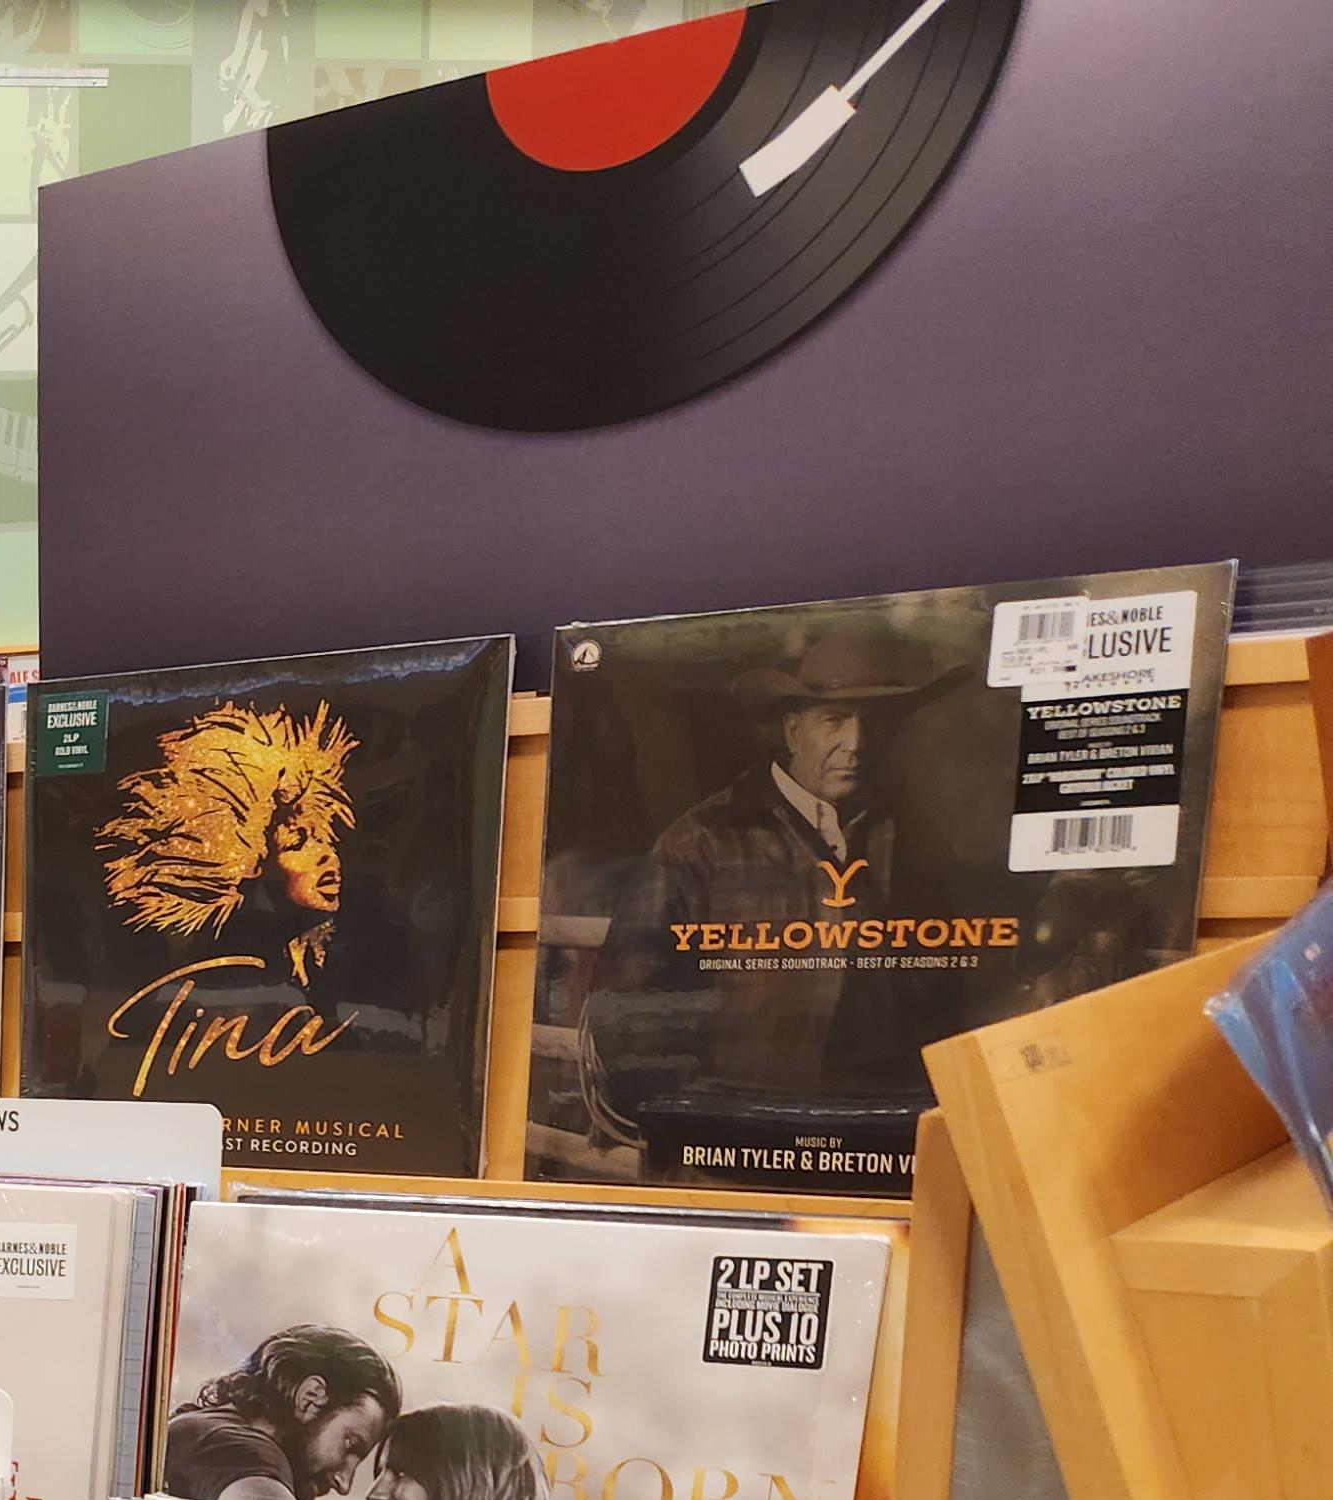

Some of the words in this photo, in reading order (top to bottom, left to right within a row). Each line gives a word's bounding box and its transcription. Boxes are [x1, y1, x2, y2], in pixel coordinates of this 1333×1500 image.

[46, 711, 98, 729] EXCLUSIVE
[1026, 695, 1183, 721] YELLOWSTONE
[63, 732, 80, 744] 2LP
[670, 916, 1021, 952] YELLOWSTONE
[699, 958, 743, 971] ORIGINAL
[744, 957, 780, 971] SERIES
[781, 957, 848, 970] SOUNDTRACK
[856, 957, 882, 969] BEST
[884, 957, 897, 969] OF
[900, 956, 948, 969] SEASONS
[950, 956, 958, 968] 2
[969, 956, 978, 968] 3
[106, 954, 360, 1098] Tina
[295, 1119, 407, 1140] MUSICAL
[795, 1135, 827, 1149] MUSIC
[829, 1137, 843, 1149] BY
[250, 1137, 359, 1158] RECORDING
[682, 1145, 737, 1168] BRIAN
[741, 1147, 796, 1171] TYLER
[801, 1150, 814, 1172] &
[818, 1150, 893, 1175] BRETON
[413, 1226, 474, 1296] A
[716, 1258, 736, 1290] 2
[738, 1259, 772, 1291] LP
[774, 1261, 825, 1294] SET
[371, 1289, 608, 1379] STAR
[710, 1308, 784, 1343] PLUS
[789, 1312, 819, 1345] 10
[708, 1338, 759, 1360] PHOTO
[760, 1342, 817, 1365] PRINTS
[505, 1372, 595, 1450] IS
